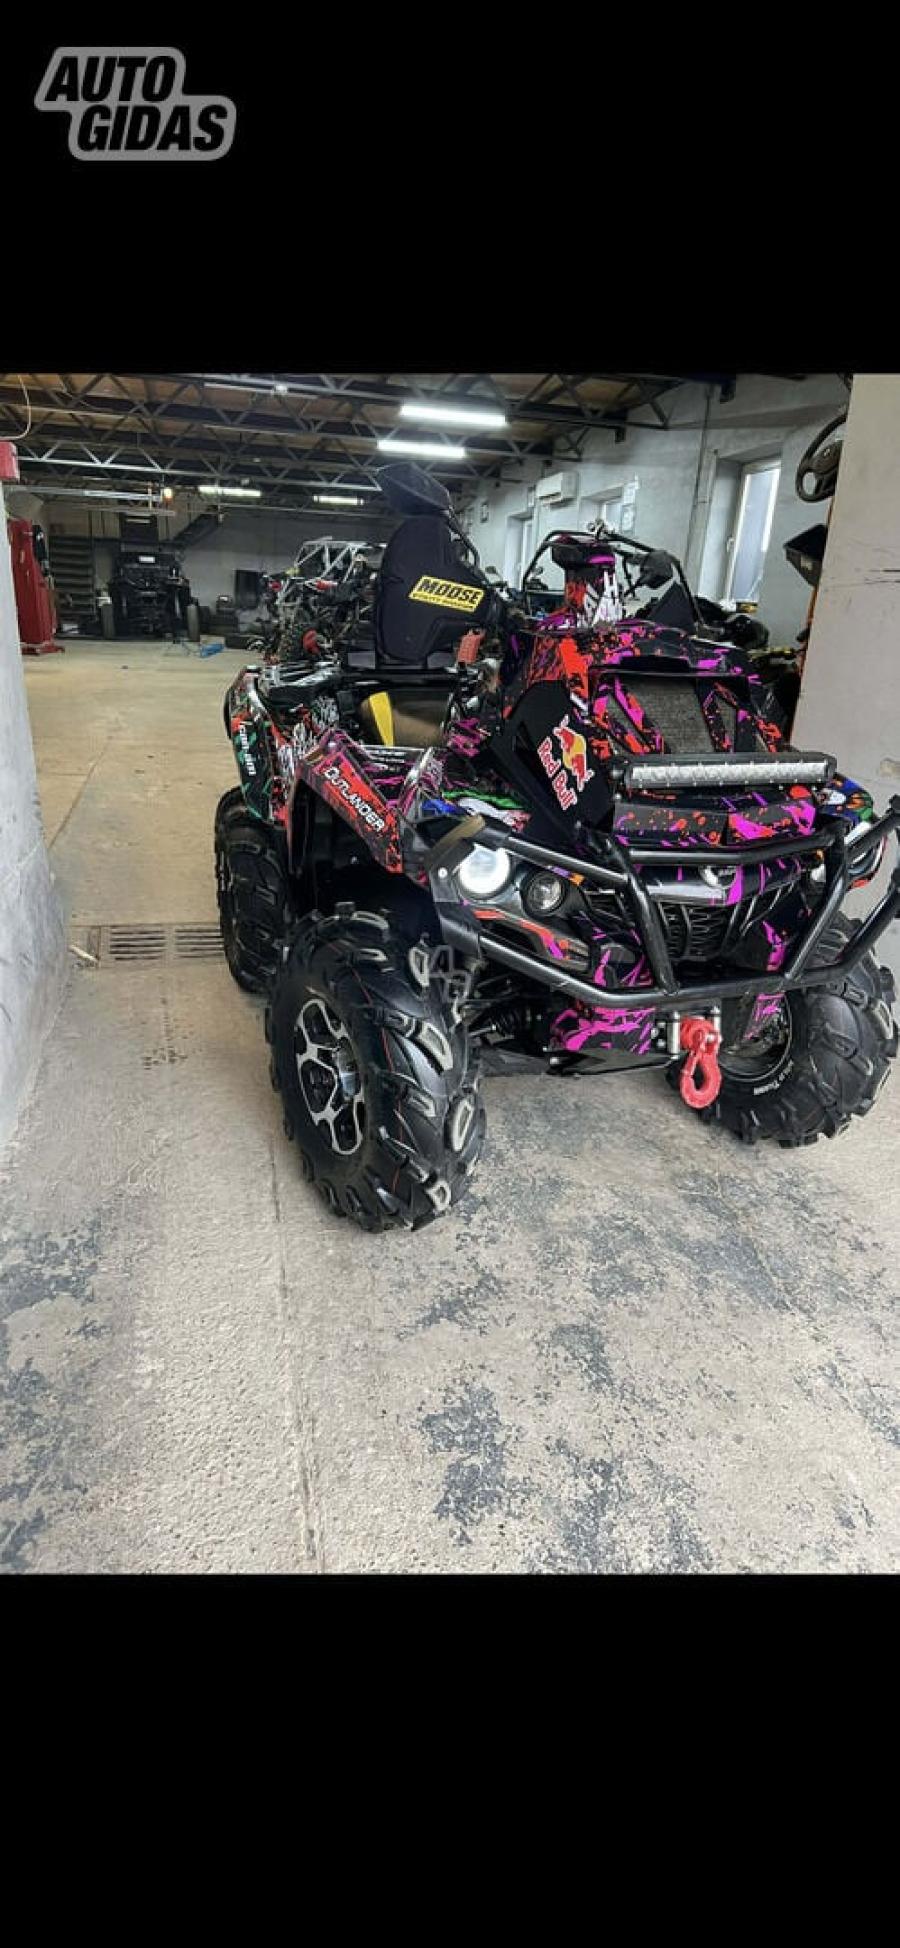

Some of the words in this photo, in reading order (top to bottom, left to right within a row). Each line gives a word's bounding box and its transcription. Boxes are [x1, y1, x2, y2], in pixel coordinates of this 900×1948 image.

[416, 578, 482, 604] MOOSE
[324, 766, 385, 832] OUTLANDER
[537, 736, 561, 778] Red
[552, 769, 578, 811] Bull
